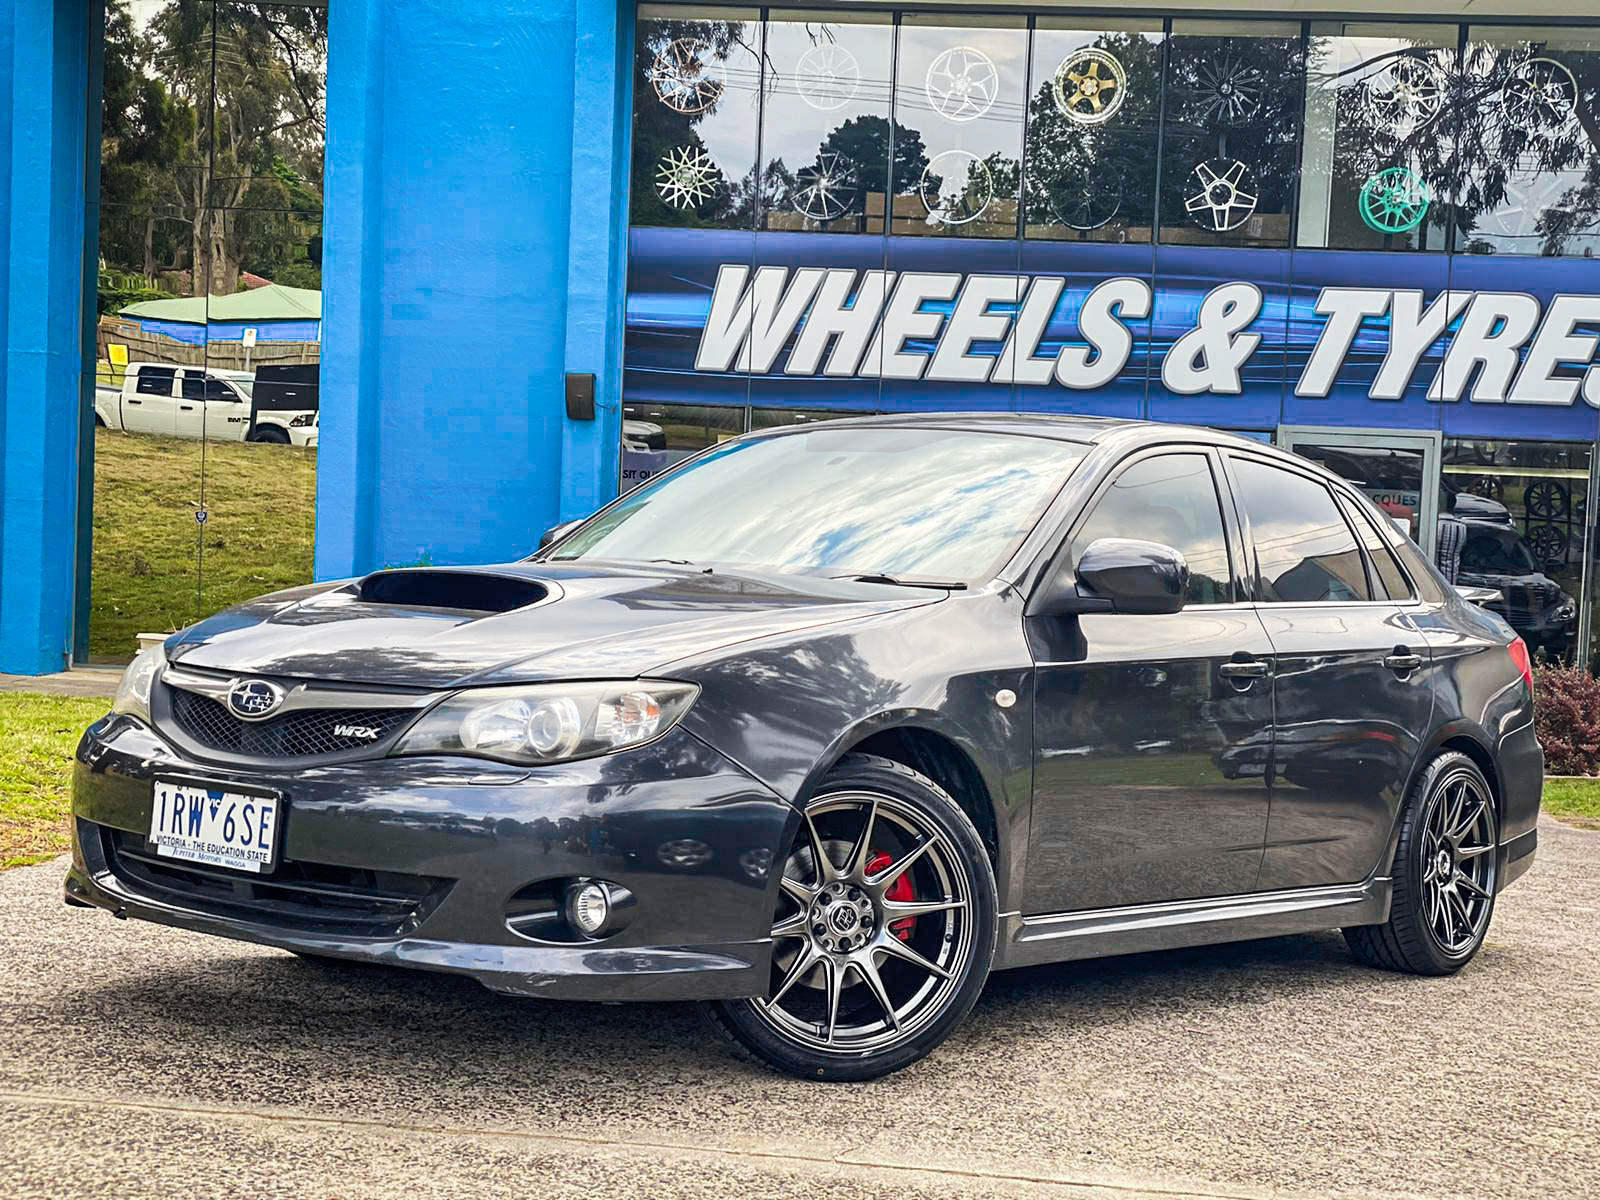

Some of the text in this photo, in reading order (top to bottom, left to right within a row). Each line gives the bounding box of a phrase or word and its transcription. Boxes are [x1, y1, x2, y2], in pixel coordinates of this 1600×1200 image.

[694, 264, 1152, 390] WHEELS
[1162, 281, 1263, 395] &
[623, 470, 636, 479] SIT
[1372, 494, 1417, 507] CQUES
[334, 724, 382, 739] WRX
[159, 791, 273, 849] 1RW 6SE
[156, 834, 186, 847] VICTORIA
[193, 841, 205, 851] THE
[207, 843, 245, 858] EDUCATION
[247, 850, 268, 862] STATE
